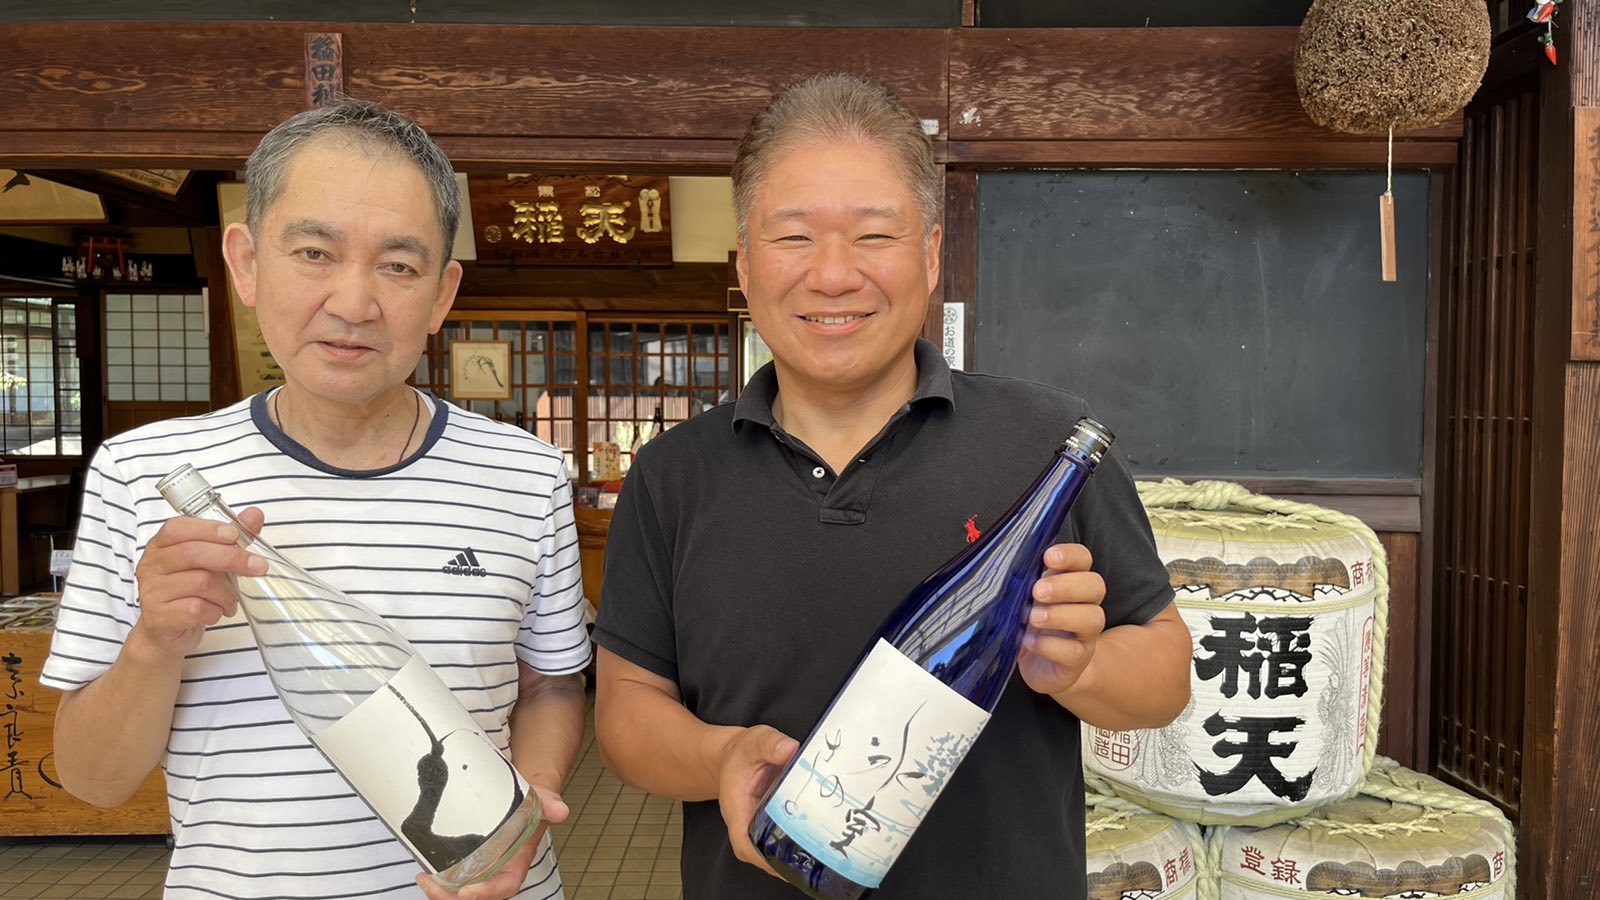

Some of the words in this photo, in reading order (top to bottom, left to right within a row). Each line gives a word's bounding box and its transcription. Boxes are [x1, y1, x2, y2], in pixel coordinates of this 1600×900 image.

[508, 200, 636, 244] 稲天
[442, 565, 487, 577] adidas
[1191, 611, 1319, 802] 稲天
[1240, 845, 1302, 885] 登録
